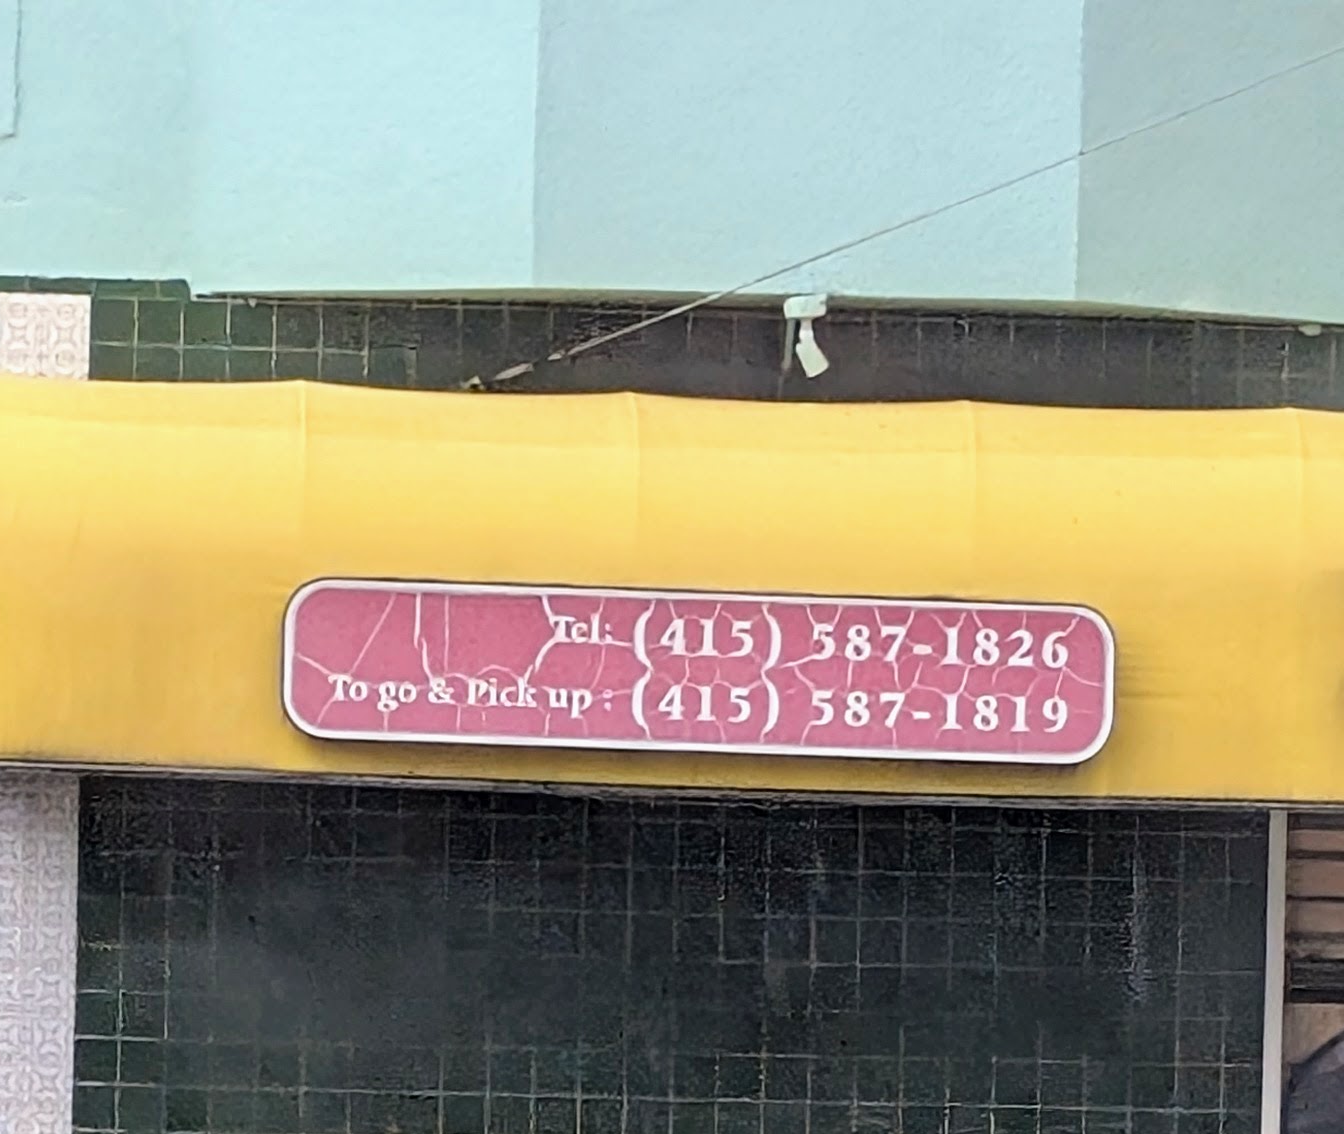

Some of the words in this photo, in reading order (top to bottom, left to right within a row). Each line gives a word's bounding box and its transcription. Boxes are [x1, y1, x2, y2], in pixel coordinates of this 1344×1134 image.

[552, 613, 613, 643] Tel:
[634, 606, 782, 671] (415)
[812, 624, 1069, 668] 587-1826
[328, 674, 368, 701] To
[377, 681, 417, 712] go
[427, 677, 455, 704] &
[467, 677, 537, 707] Pick
[549, 687, 593, 718] up
[632, 672, 780, 738] (415)
[810, 690, 1068, 733] 587-1819
